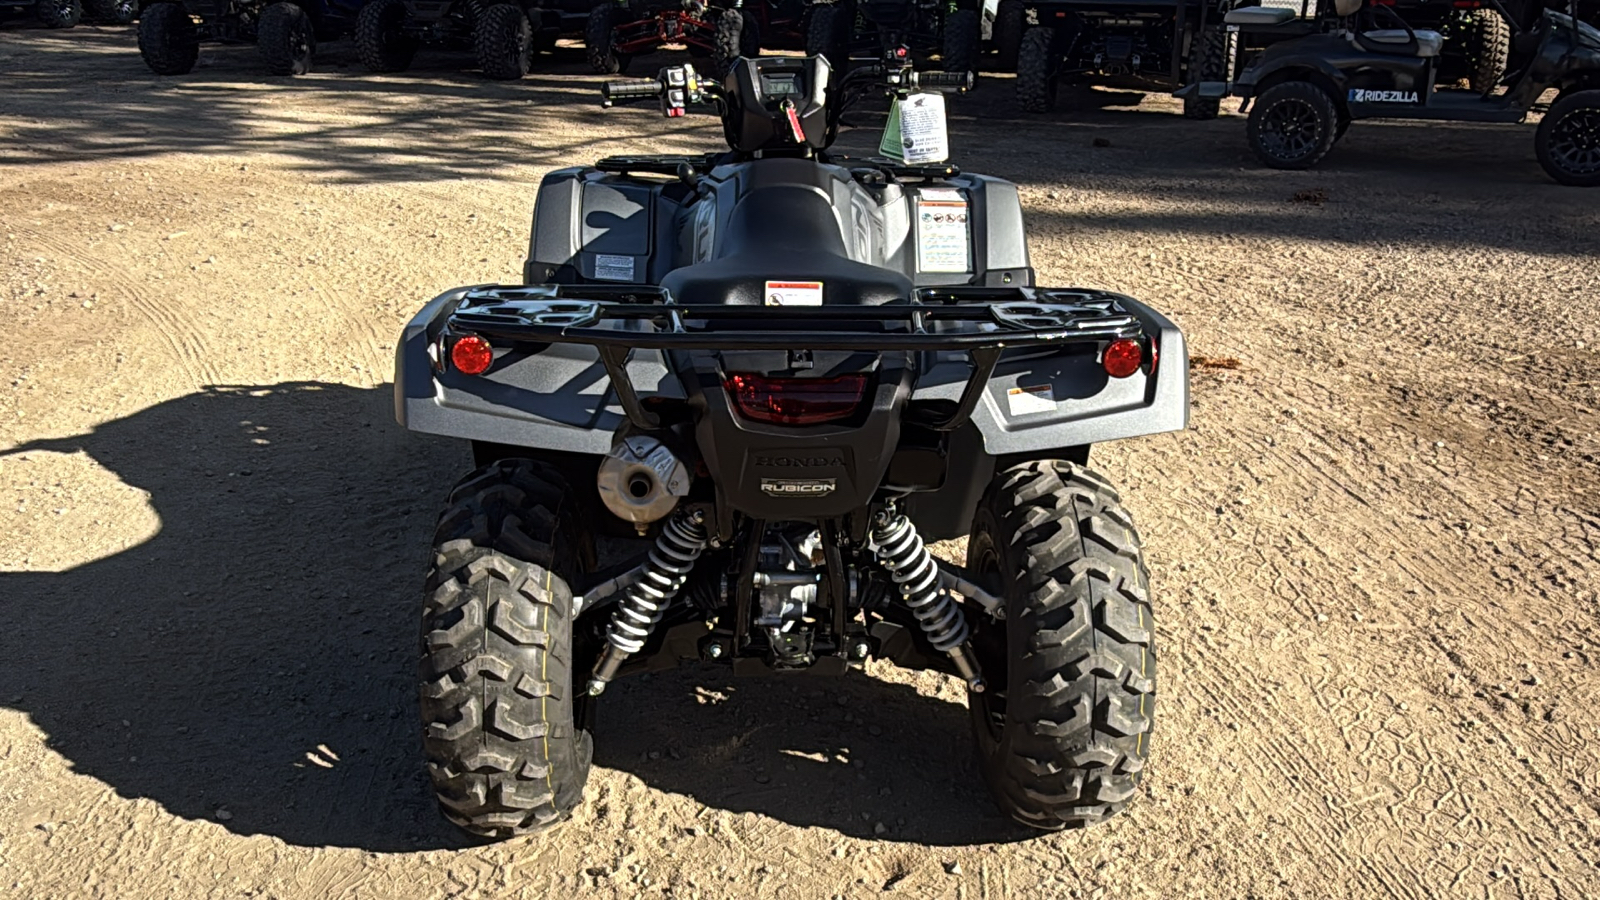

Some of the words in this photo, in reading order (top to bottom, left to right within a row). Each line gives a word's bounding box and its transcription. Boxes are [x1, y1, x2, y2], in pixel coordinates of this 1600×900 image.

[1365, 91, 1418, 103] RIDEZILLA
[755, 456, 847, 467] HONDA
[761, 484, 835, 492] RUBICON
